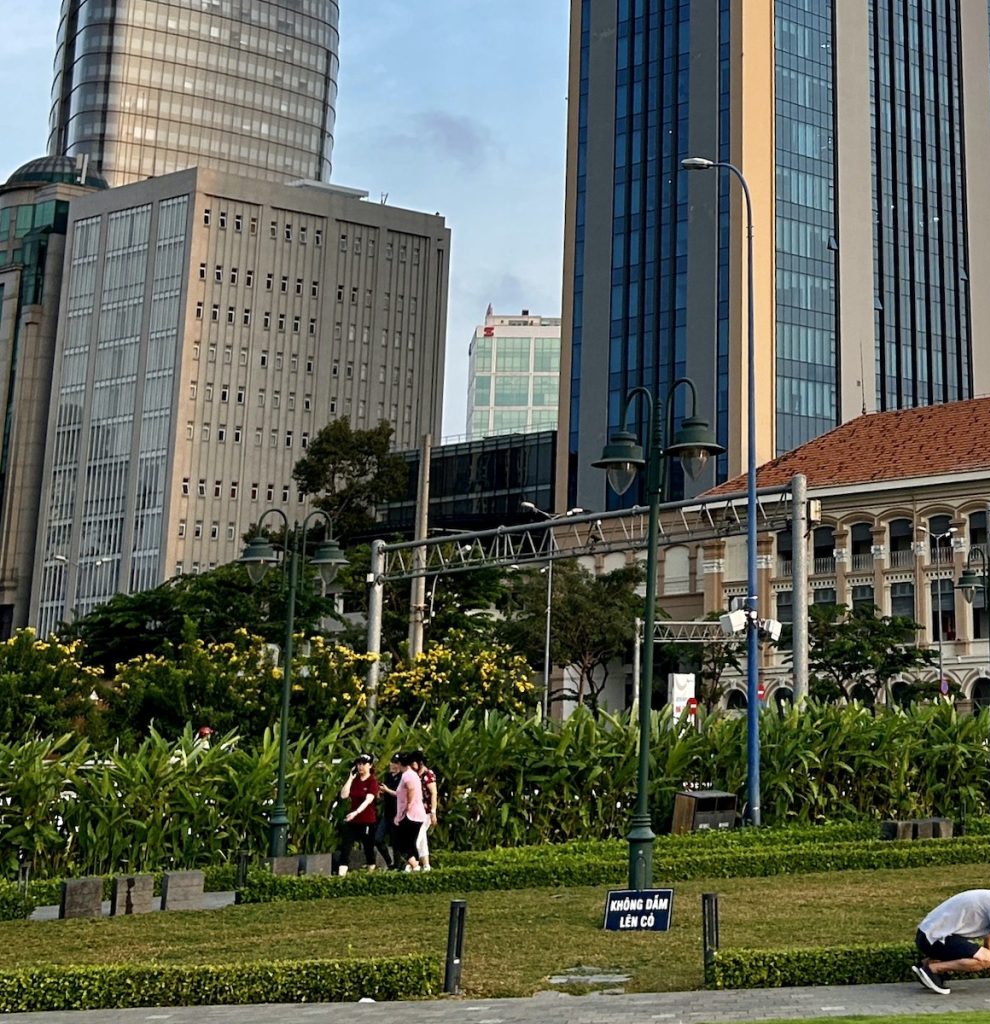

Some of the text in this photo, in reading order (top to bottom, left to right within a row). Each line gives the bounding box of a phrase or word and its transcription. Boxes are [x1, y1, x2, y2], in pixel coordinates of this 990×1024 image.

[610, 896, 643, 912] KHÔNG
[619, 912, 655, 928] LÊN CỎ
